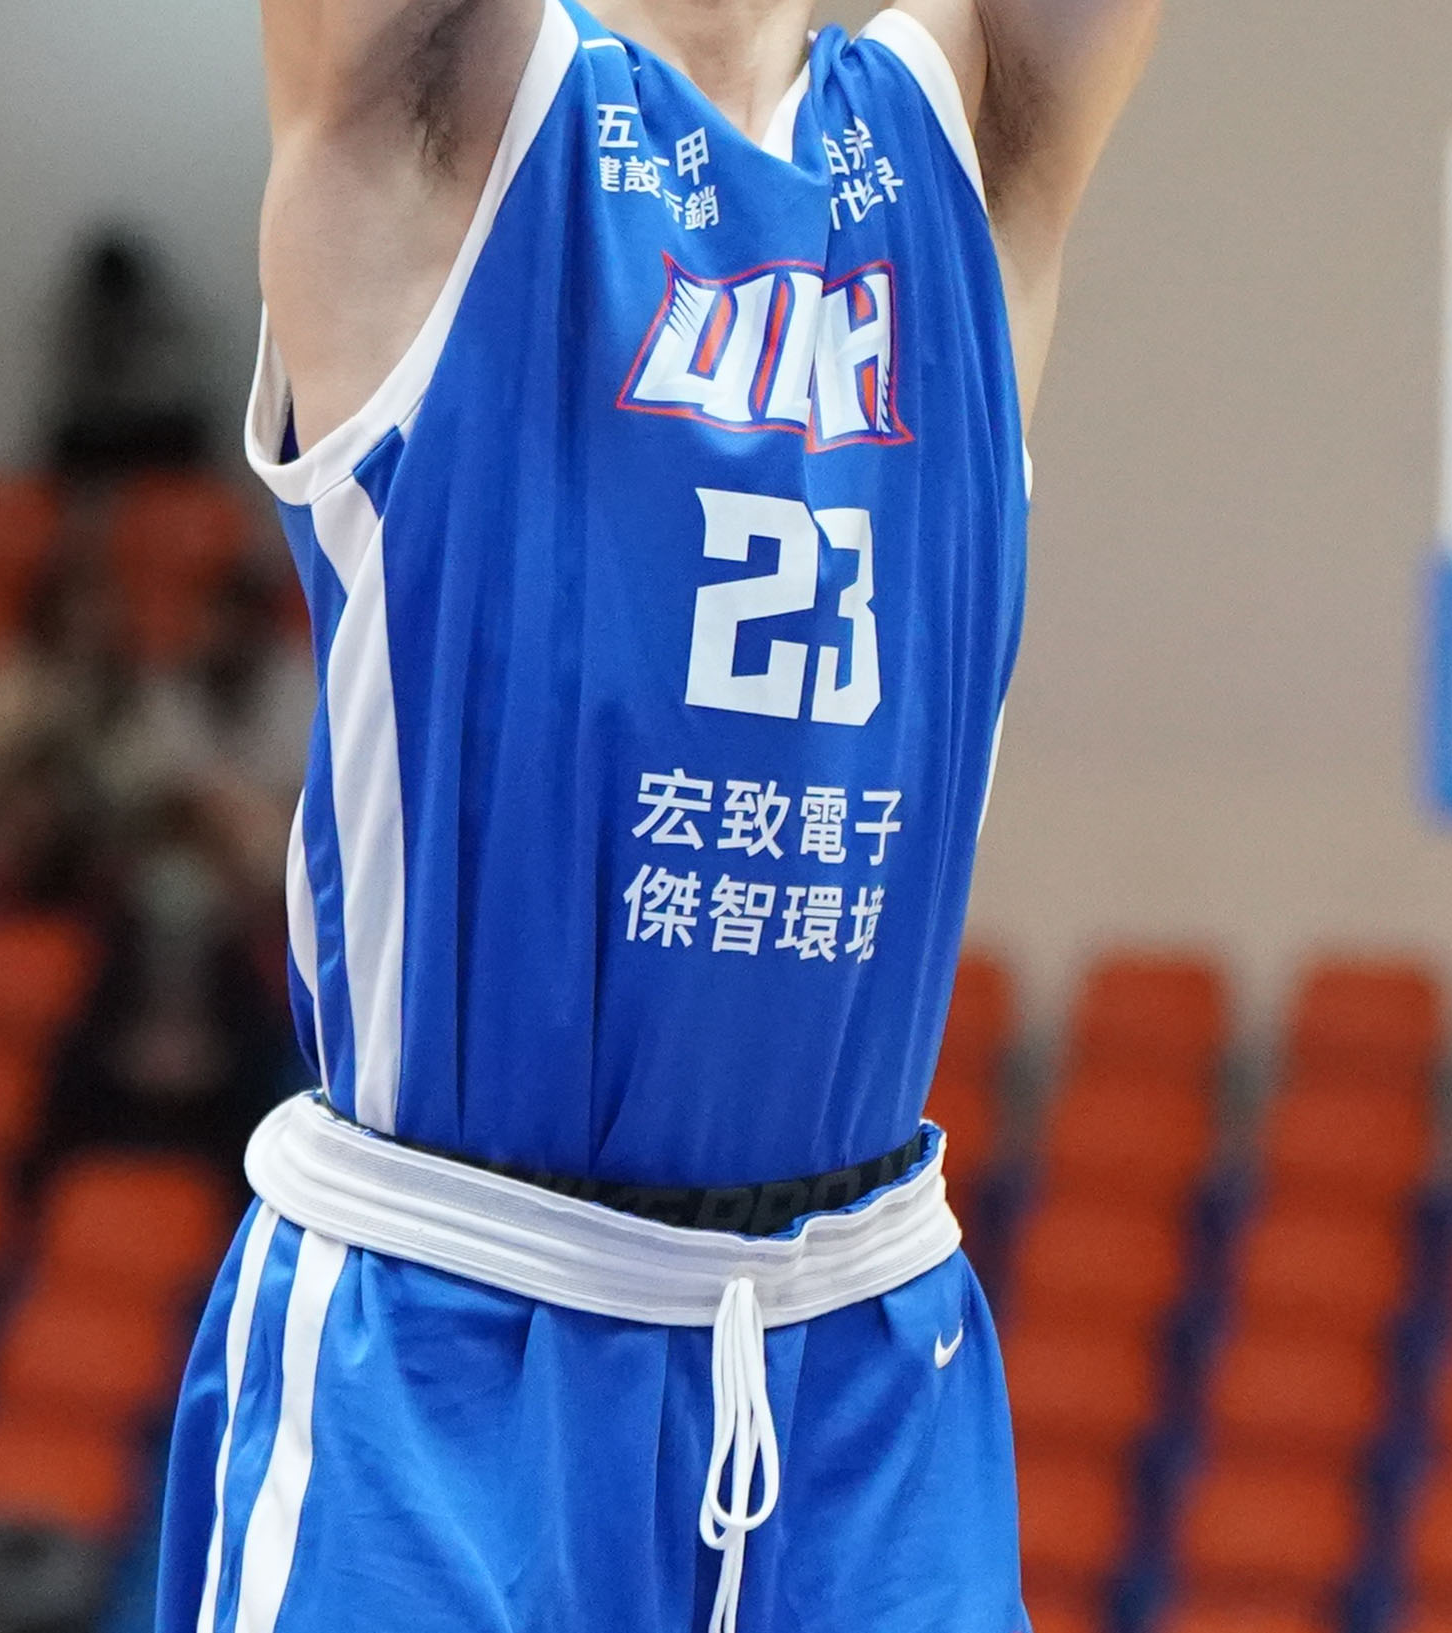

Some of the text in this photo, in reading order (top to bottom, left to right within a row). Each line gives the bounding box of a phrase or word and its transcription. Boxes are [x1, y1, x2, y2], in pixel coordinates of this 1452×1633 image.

[685, 488, 881, 726] 23
[631, 768, 903, 866] 宏致電子
